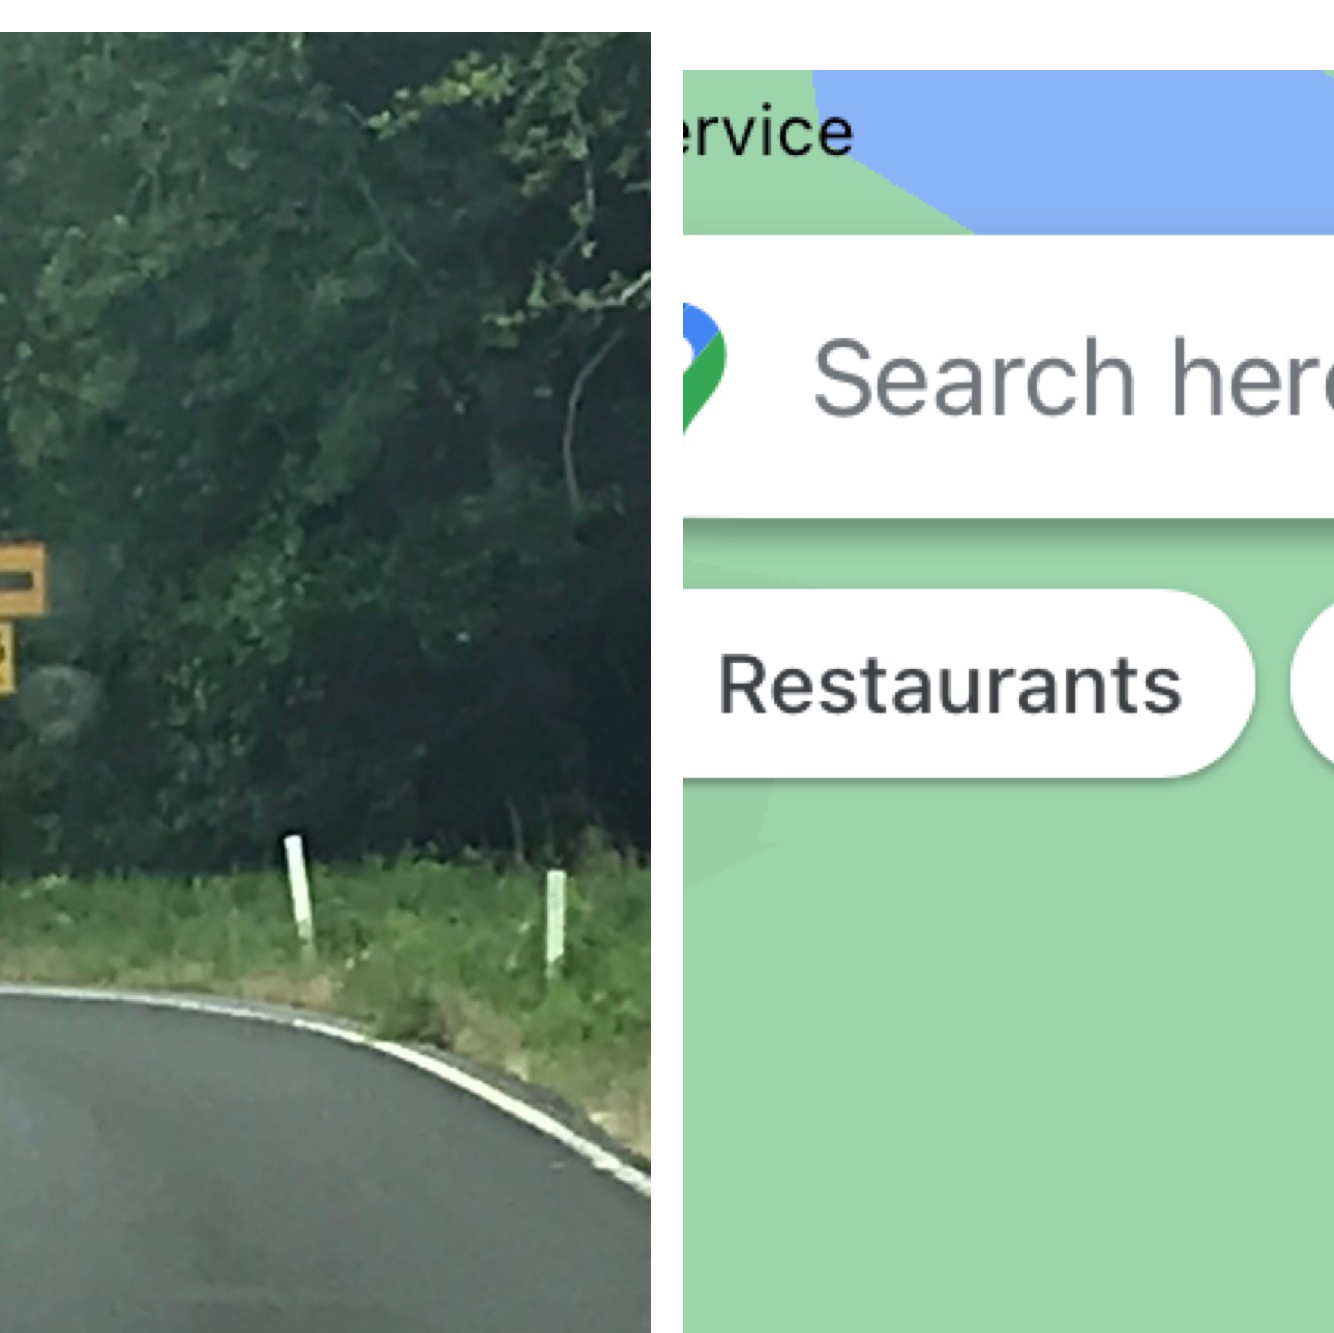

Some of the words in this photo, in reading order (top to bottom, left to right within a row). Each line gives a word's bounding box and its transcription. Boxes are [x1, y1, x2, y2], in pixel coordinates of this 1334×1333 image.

[683, 102, 853, 156] rvice
[815, 337, 1133, 418] Search
[722, 653, 1182, 714] Restaurants
